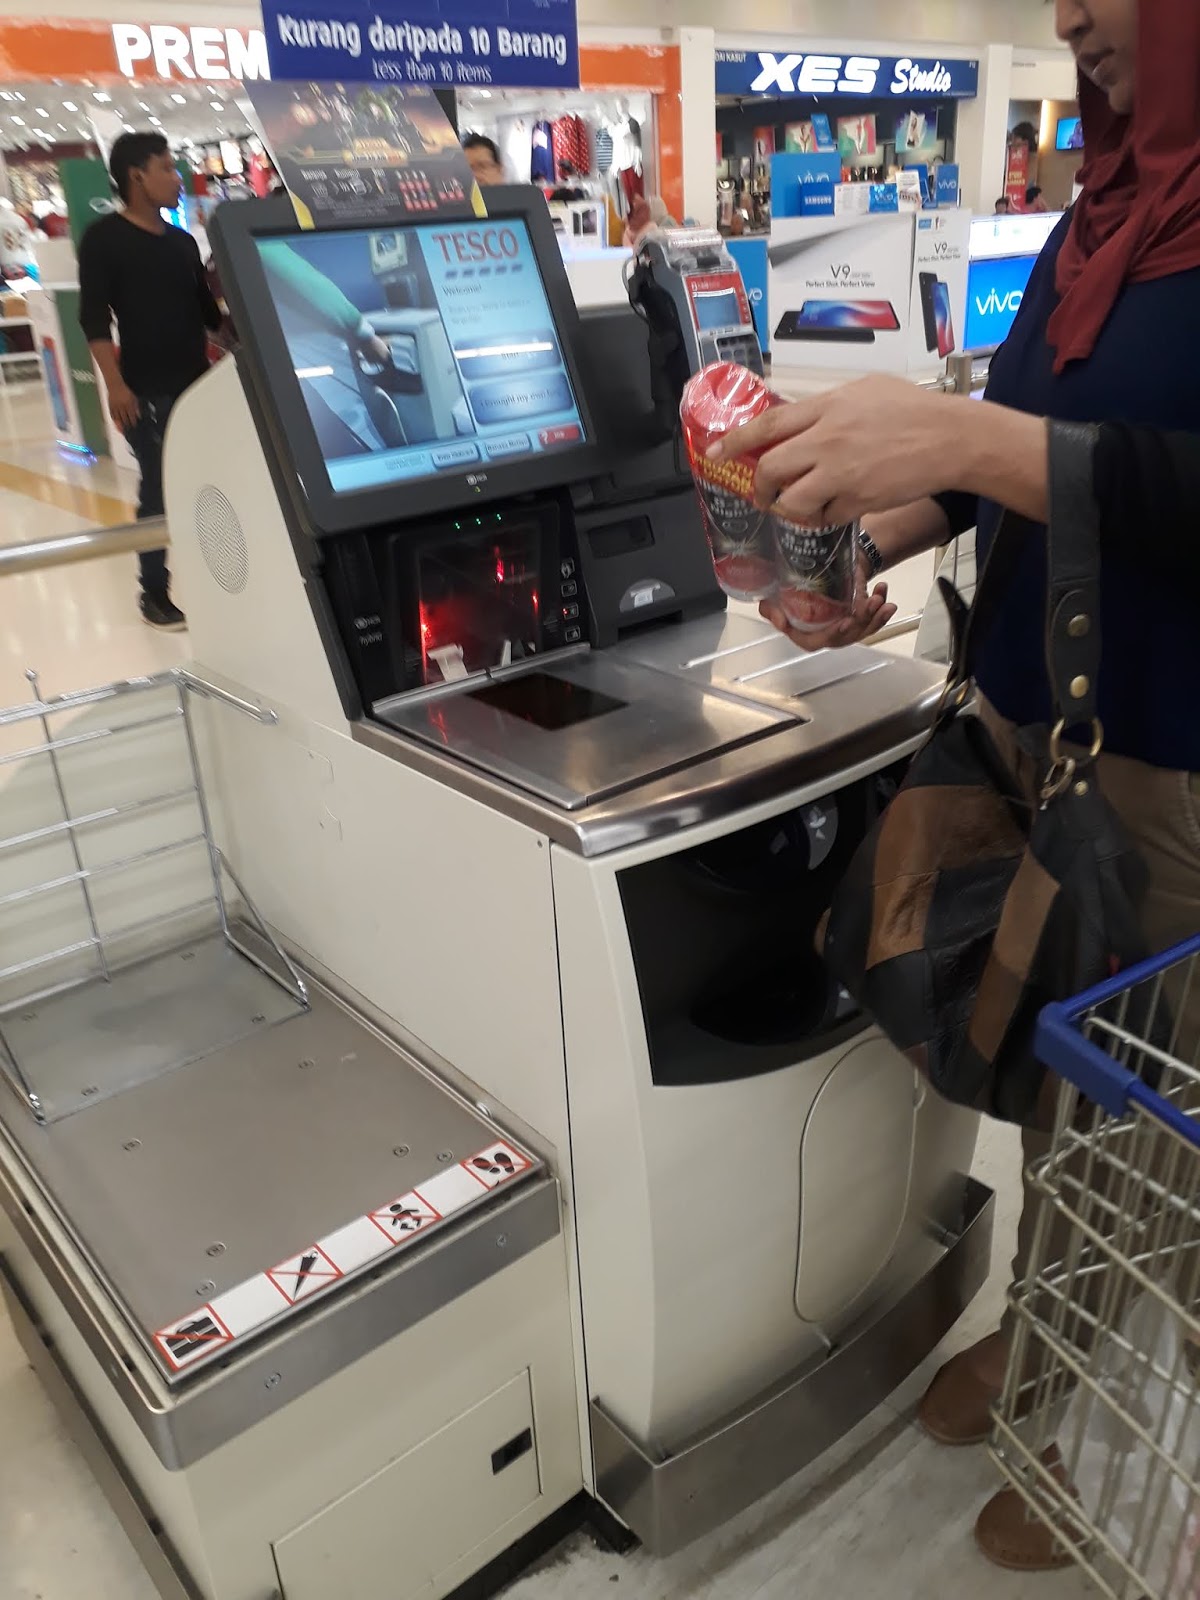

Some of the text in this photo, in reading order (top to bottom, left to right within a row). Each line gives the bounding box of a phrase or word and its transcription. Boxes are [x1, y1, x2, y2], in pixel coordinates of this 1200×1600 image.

[277, 13, 567, 65] Kurang daripada 10 Barang
[405, 58, 436, 81] than
[440, 61, 453, 82] 10
[456, 61, 493, 83] items
[750, 53, 951, 94] XES Studio
[432, 228, 519, 264] TESCO
[830, 264, 851, 279] V9
[975, 287, 1024, 316] vivo
